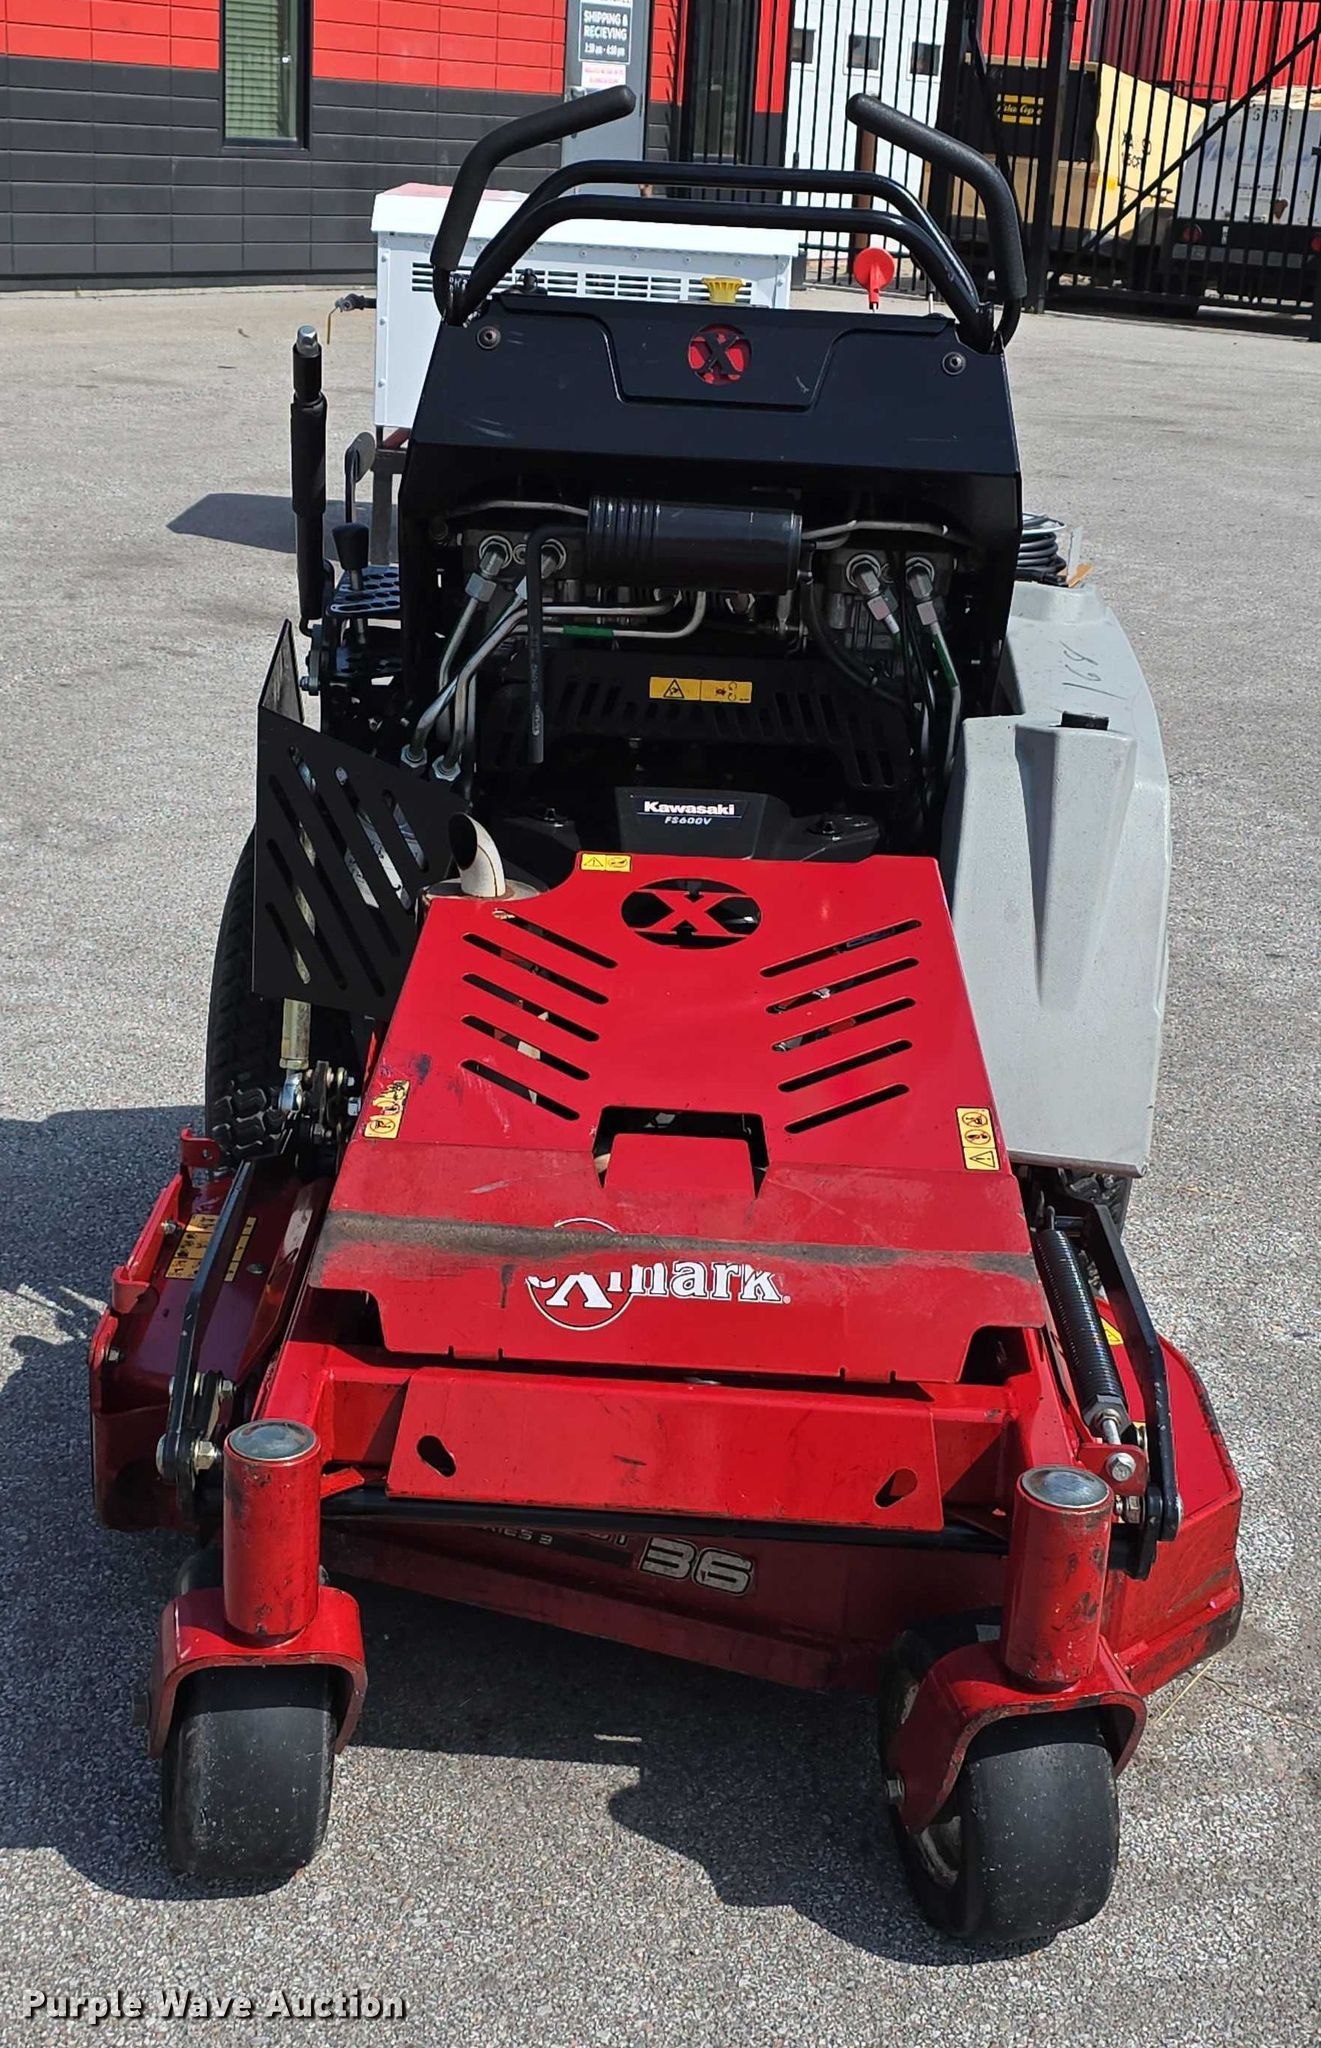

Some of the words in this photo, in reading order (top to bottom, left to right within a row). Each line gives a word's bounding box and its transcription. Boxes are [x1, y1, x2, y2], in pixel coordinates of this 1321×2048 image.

[584, 9, 621, 27] SHIPPING
[584, 25, 628, 42] RECIEVING
[1019, 104, 1043, 116] Copo
[644, 801, 736, 815] Kawasaki
[664, 816, 713, 826] FS600V
[639, 1536, 754, 1596] 36
